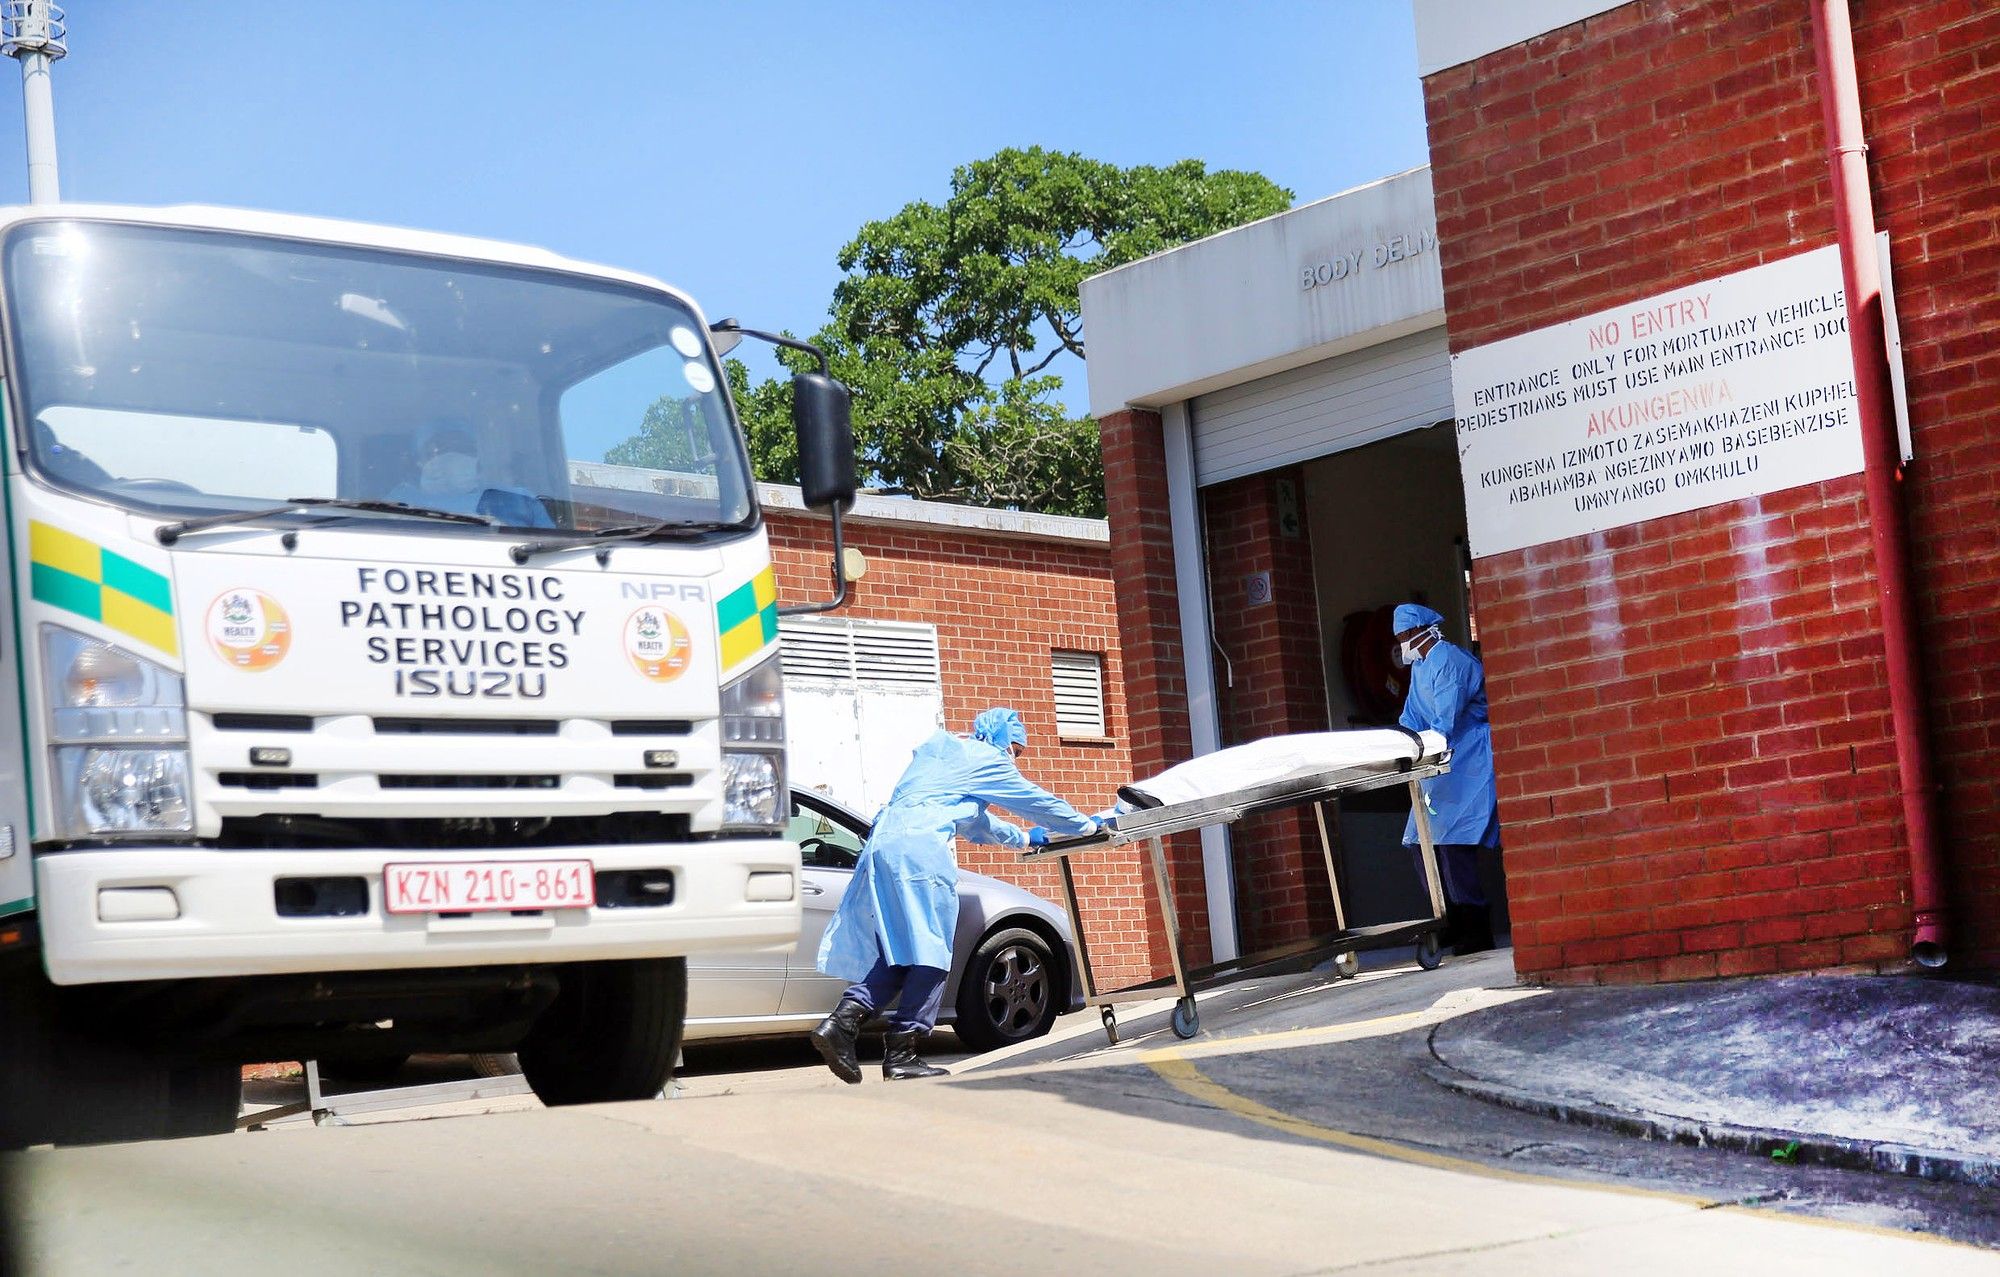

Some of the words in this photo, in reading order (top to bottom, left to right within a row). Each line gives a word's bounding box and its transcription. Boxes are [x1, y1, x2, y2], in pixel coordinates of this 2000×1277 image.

[1302, 250, 1363, 291] BODY
[1588, 321, 1620, 351] NO
[1632, 293, 1711, 340] ENTRY
[1456, 390, 1567, 435] PEDESTRIANS
[1573, 377, 1617, 403] MUST
[1625, 367, 1660, 389] USE
[1663, 354, 1704, 380] MAIN
[1710, 327, 1806, 367] ENTRANCE
[1474, 369, 1560, 407] ENTRANCE
[1572, 354, 1615, 379] ONLY
[1623, 344, 1658, 367] FOR
[1662, 315, 1757, 357] MORTUARY
[1587, 379, 1733, 438] AKUNGENWA
[1480, 456, 1556, 489] KUNGENA
[1562, 437, 1628, 469] IZIMOTO
[1633, 399, 1780, 451] ZASEMAKHAZENI
[1509, 470, 1597, 505] ABAHAMBA
[1604, 441, 1714, 482] NGEZINYAWO
[1722, 407, 1849, 453] BASEBENZISE
[1575, 477, 1666, 512] UMNYANGO
[1675, 455, 1759, 488] OMKHULU
[358, 567, 565, 601] FORENSIC
[621, 582, 706, 602] NPR
[340, 601, 586, 636] PATHOLOGY
[367, 636, 570, 669] SERVICES
[395, 669, 547, 699] ISUZU
[397, 870, 449, 904] KZN
[464, 867, 585, 902] 210-861
